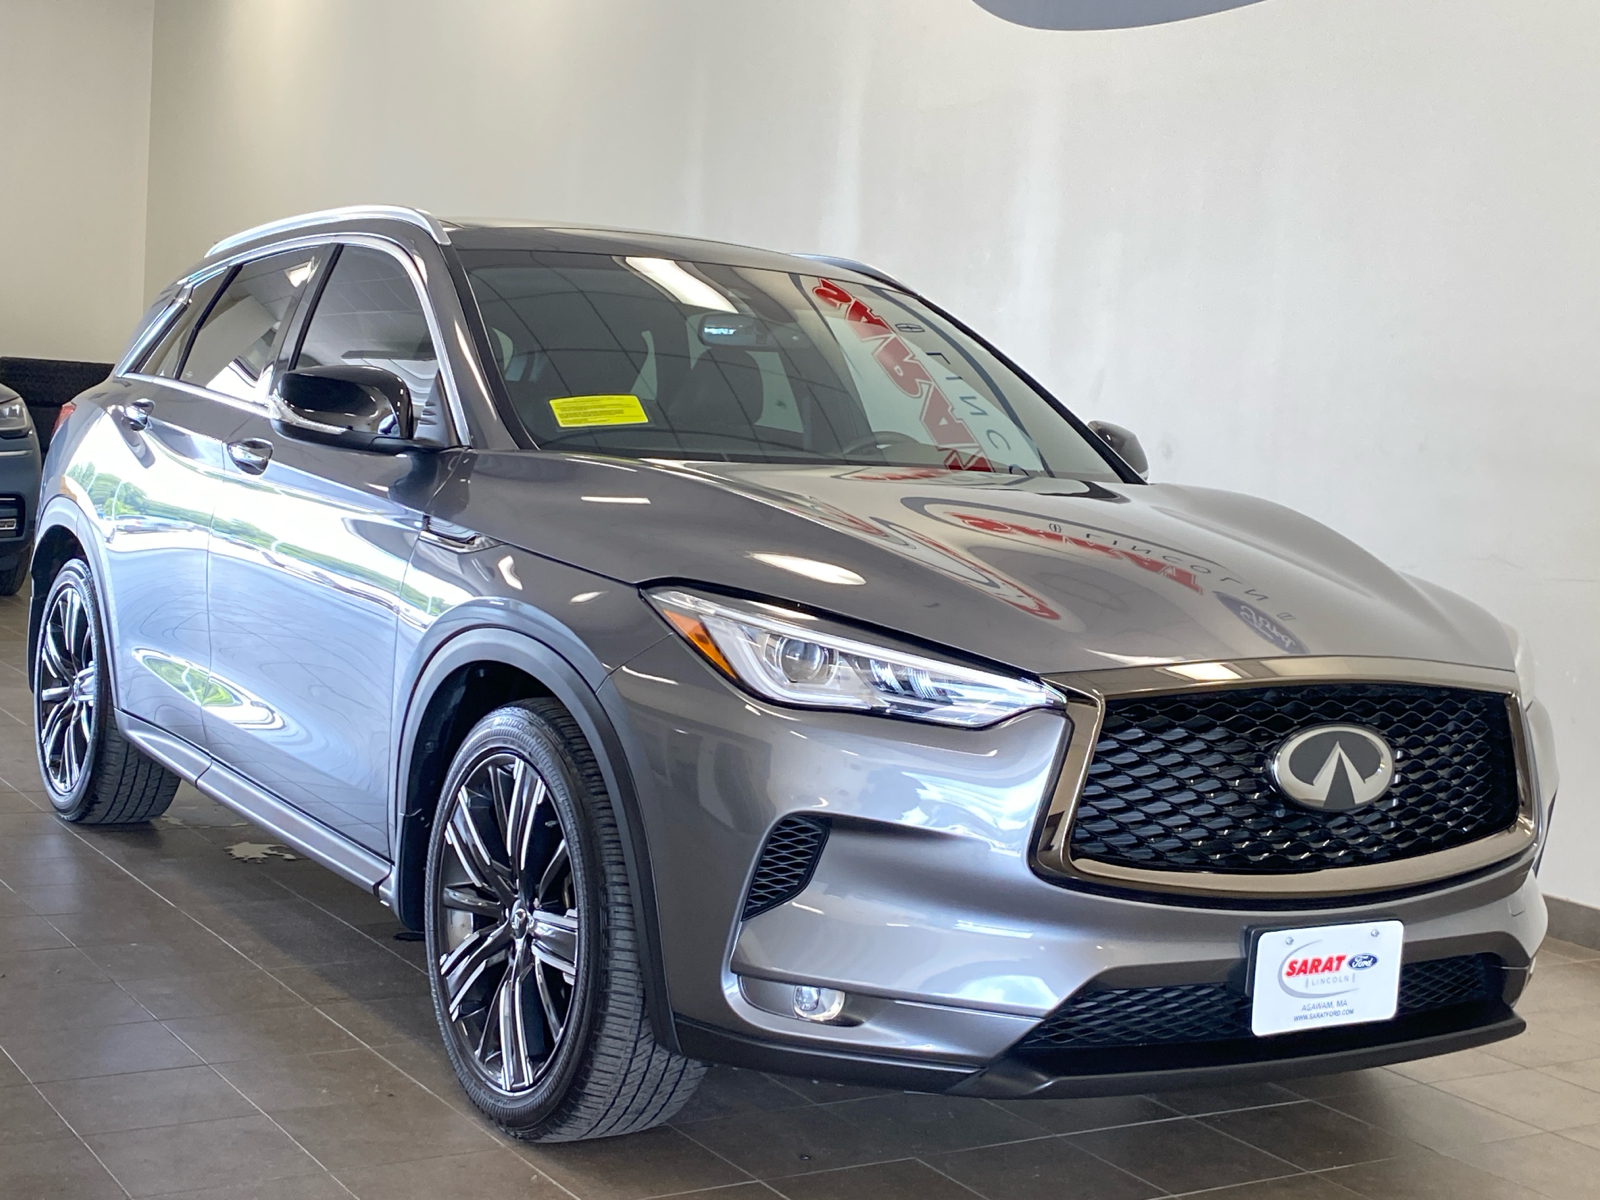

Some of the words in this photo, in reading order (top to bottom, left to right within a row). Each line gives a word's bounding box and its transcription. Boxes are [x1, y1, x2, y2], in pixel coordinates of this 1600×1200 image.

[1285, 954, 1347, 977] SARAT
[1351, 954, 1374, 968] Ford
[1311, 975, 1350, 986] LINCOLN
[1301, 1001, 1335, 1012] AGAWAM,
[1336, 999, 1348, 1007] MA
